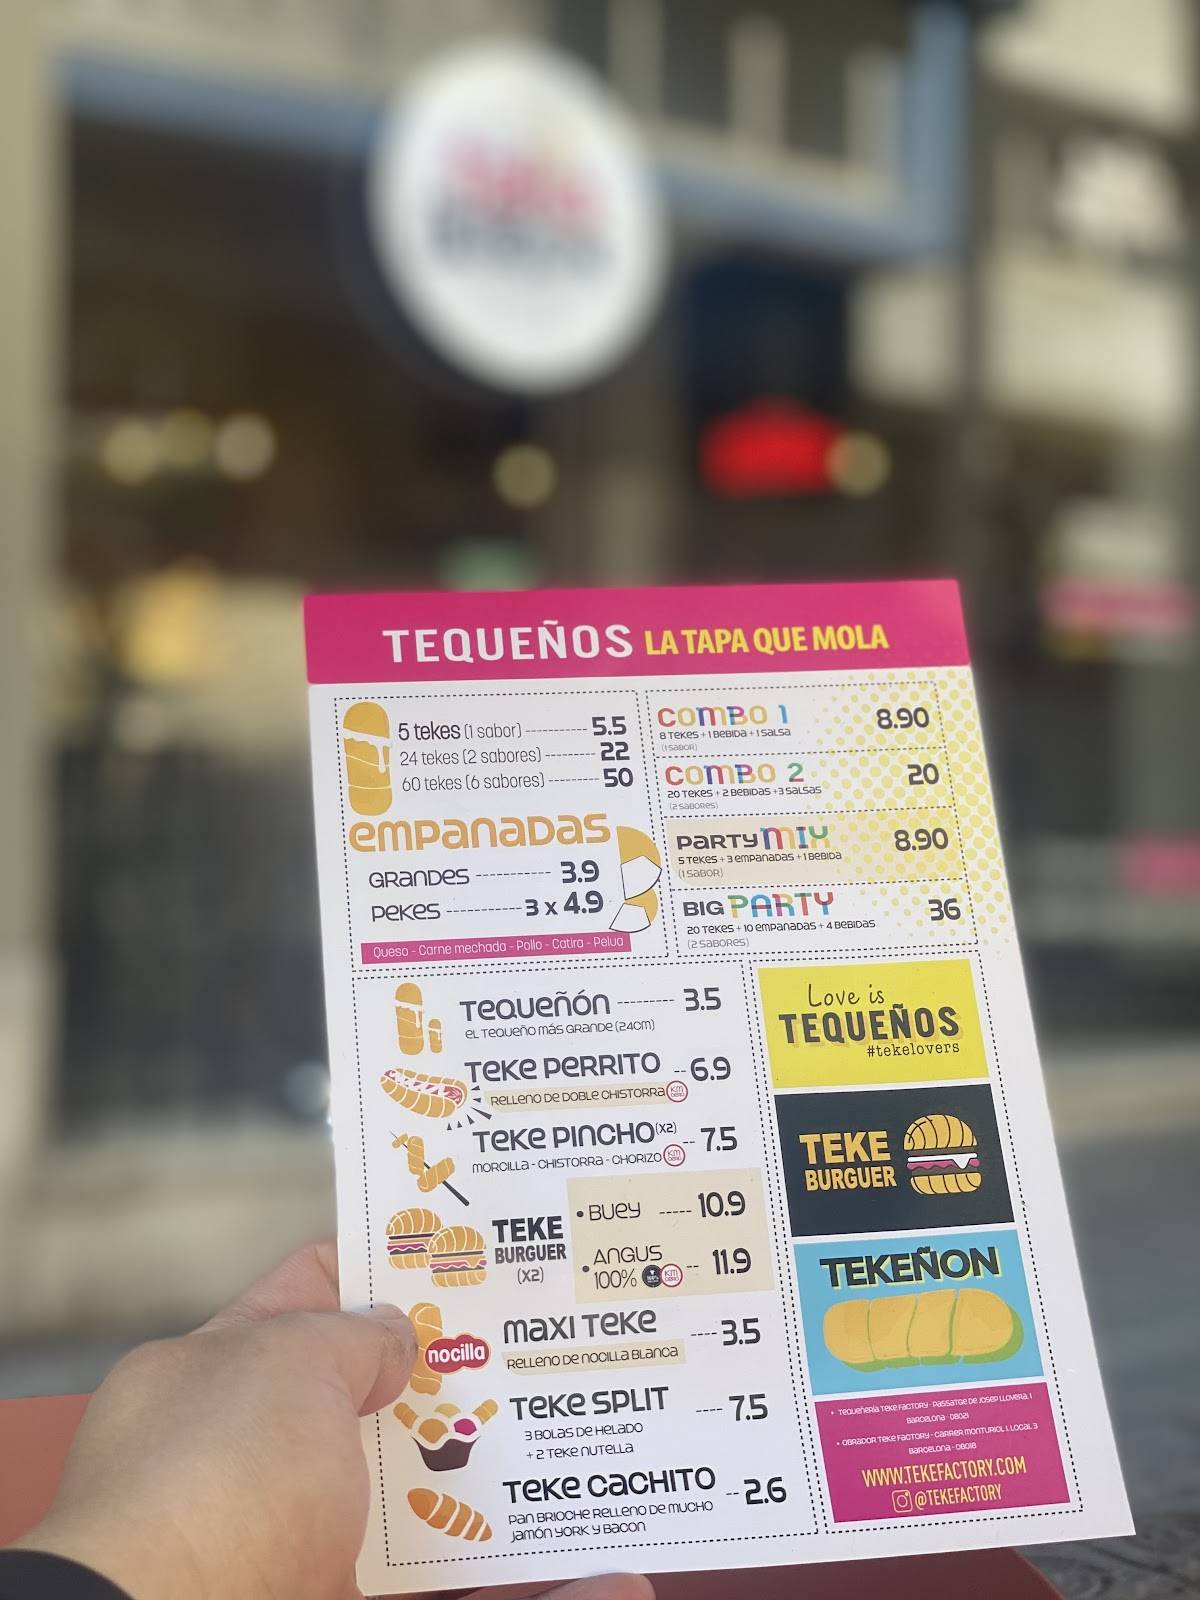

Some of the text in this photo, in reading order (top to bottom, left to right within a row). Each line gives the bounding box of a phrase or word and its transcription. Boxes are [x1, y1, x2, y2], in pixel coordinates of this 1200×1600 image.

[382, 620, 889, 663] TEQUEÑOS LA TAPA QUE MOLA
[398, 716, 626, 740] 5 tekes (1 sabor) 5.5
[778, 704, 788, 724] 1
[877, 707, 929, 730] 8.90
[400, 742, 630, 766] 24 tekes (2 sabores) 22
[402, 768, 634, 791] 60 tekes (6 sabores) 50
[788, 762, 804, 782] 2
[907, 763, 939, 785] 20
[894, 827, 949, 852] 8.90
[727, 855, 734, 863] 3
[561, 860, 599, 884] 3.9
[525, 899, 538, 916] 3
[564, 890, 604, 914] 4.9
[683, 892, 961, 921] BIG PARTY 36
[688, 926, 700, 934] 20
[744, 923, 754, 932] 10
[373, 935, 623, 958] Queso Carne mechada Pollo Catira Pelua
[684, 987, 721, 1011] 3.5
[808, 983, 884, 1007] Love is
[779, 1003, 960, 1044] TEQUEÑOS
[867, 1042, 960, 1057] #tekelovers
[691, 1057, 731, 1081] 6.9
[701, 1126, 737, 1151] 7.5
[799, 1131, 891, 1165] TEKE
[612, 1153, 662, 1165] CHORIZO
[805, 1166, 897, 1192] BURGUER
[698, 1191, 745, 1217] 10.9
[492, 1216, 563, 1243] TEKE
[495, 1243, 567, 1264] BURGUER
[712, 1248, 751, 1275] 11.9
[594, 1268, 637, 1289] 100%
[820, 1246, 1000, 1288] TEKEÑON
[721, 1318, 761, 1346] 3.5
[428, 1343, 485, 1364] nocilla
[592, 1386, 669, 1415] SPLIT
[729, 1393, 768, 1421] 7.5
[525, 1431, 532, 1440] 3
[537, 1450, 544, 1459] 2
[861, 1456, 1027, 1488] WWW.TEKEFACTORY.COM
[744, 1476, 787, 1505] 2.6
[915, 1484, 1002, 1511] @TEKEFACTORY
